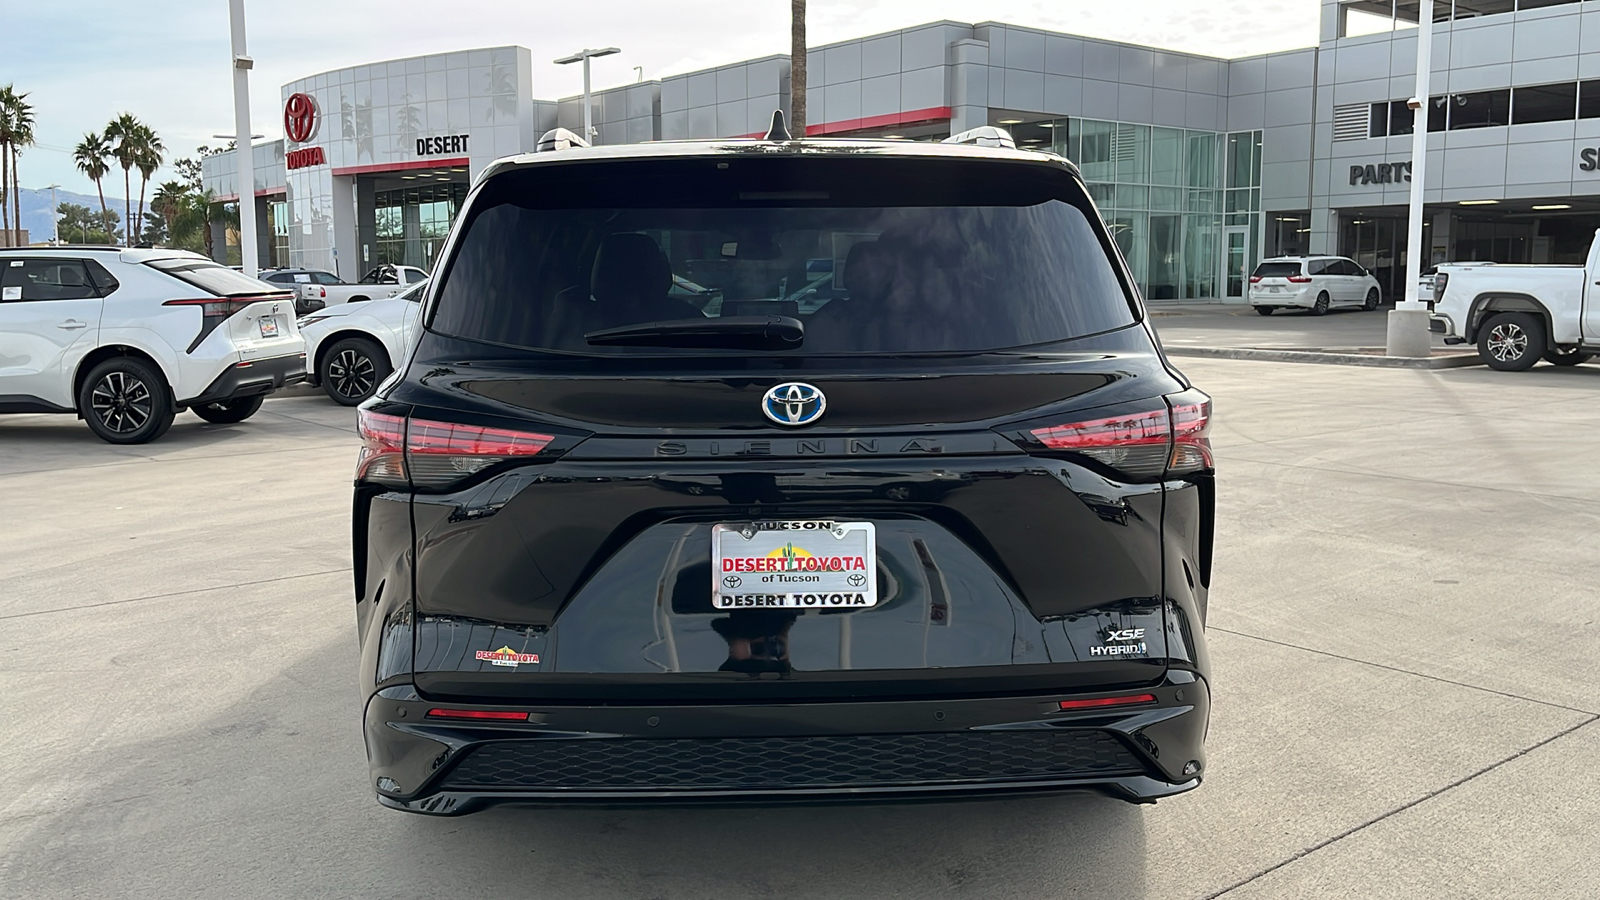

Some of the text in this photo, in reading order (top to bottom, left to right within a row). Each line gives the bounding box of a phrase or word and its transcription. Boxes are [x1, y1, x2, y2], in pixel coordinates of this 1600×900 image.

[416, 134, 470, 156] DESERT
[285, 147, 326, 169] TOYOTA
[655, 438, 939, 456] SIENNA
[755, 521, 831, 530] TUCSON
[722, 556, 865, 572] DESERT TOYOTA
[761, 574, 820, 583] of Tucson
[721, 593, 866, 607] DESERT TOYOTA
[1105, 628, 1146, 642] XSE
[476, 651, 504, 661] DESERT
[507, 653, 539, 663] TOYOTA
[1090, 645, 1138, 656] HYBRID
